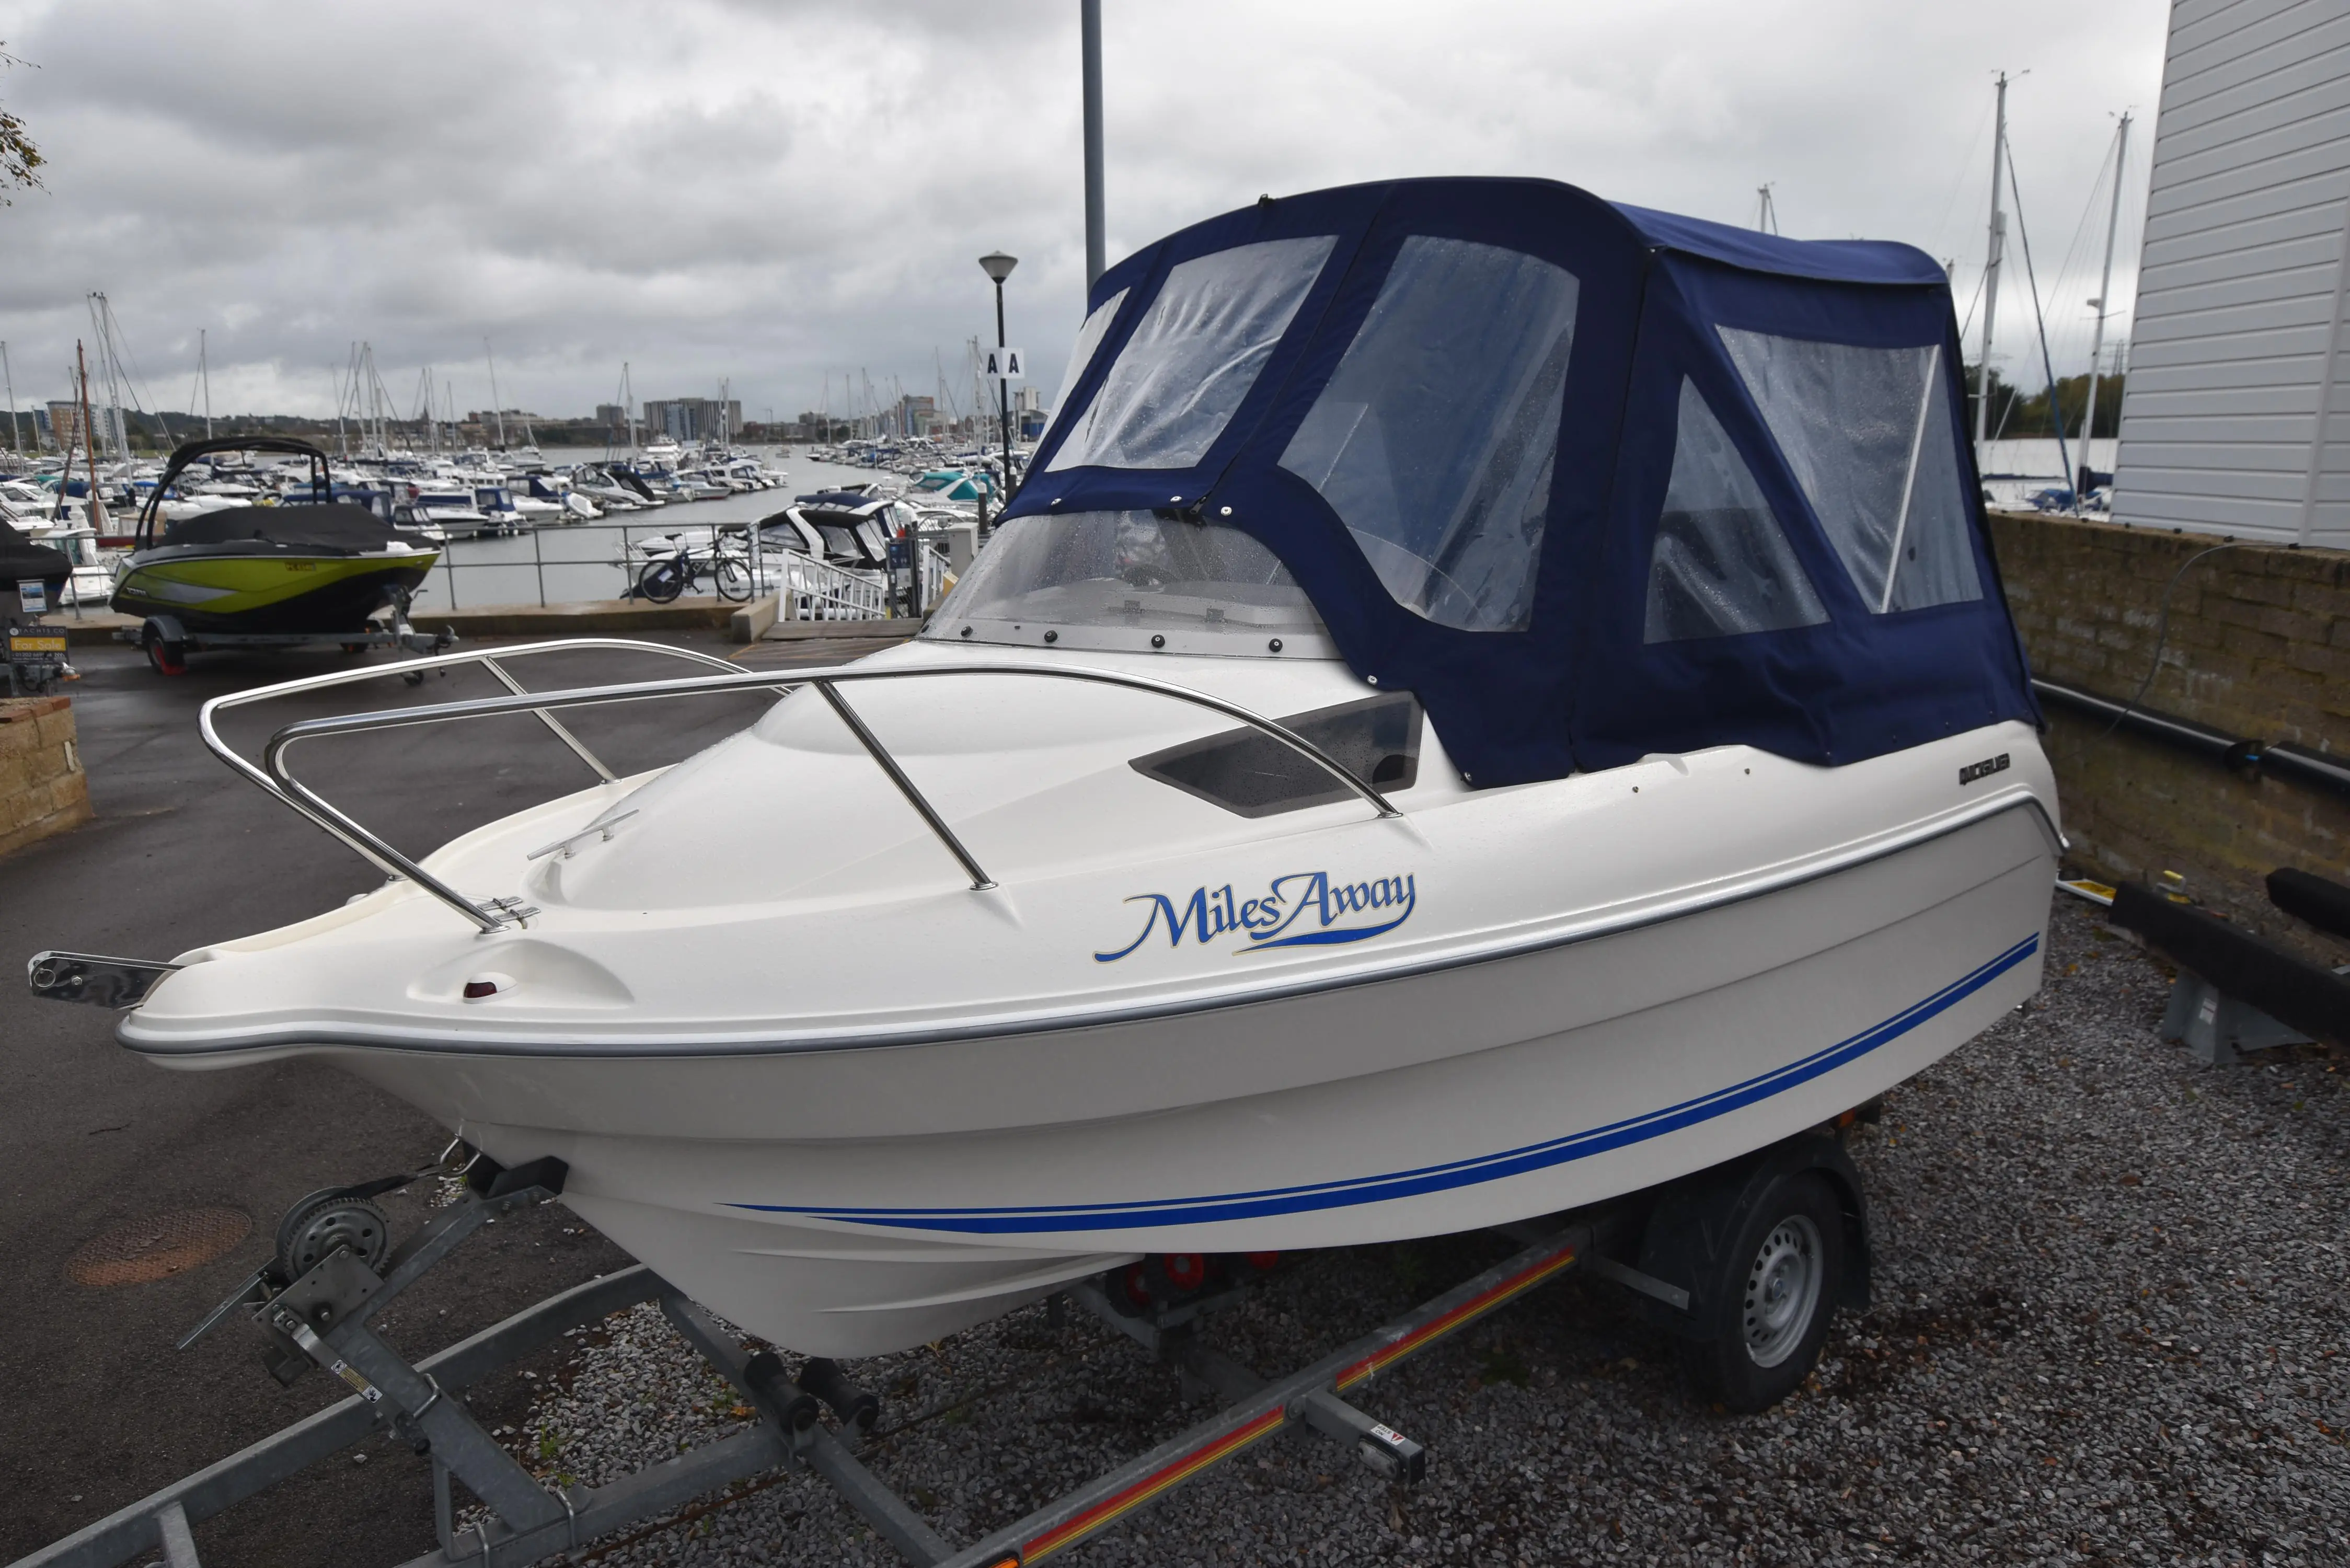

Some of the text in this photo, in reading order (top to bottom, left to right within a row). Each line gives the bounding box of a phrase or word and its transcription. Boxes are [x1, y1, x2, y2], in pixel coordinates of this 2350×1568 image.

[987, 353, 998, 373] A
[1008, 353, 1019, 373] A
[15, 639, 62, 650] For Sale
[1092, 871, 1416, 963] Miles Away
[1377, 1426, 1392, 1434] STEP
